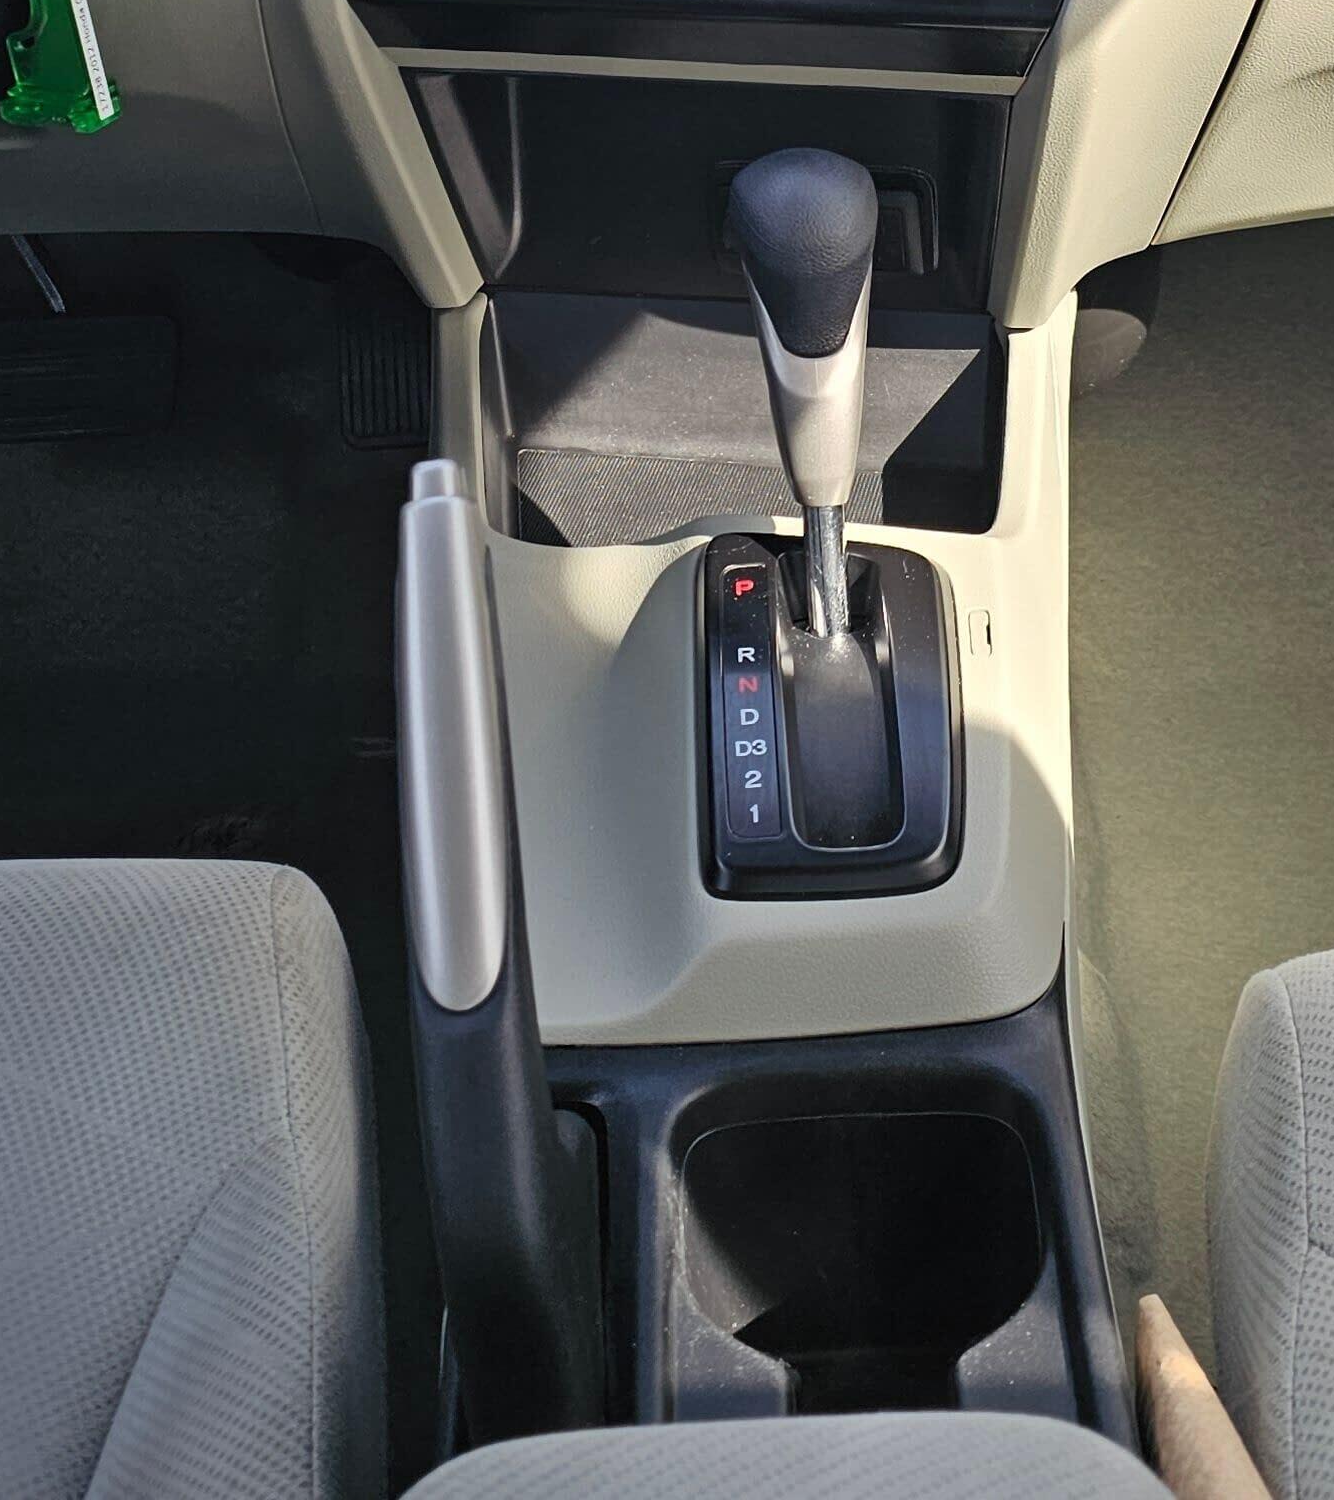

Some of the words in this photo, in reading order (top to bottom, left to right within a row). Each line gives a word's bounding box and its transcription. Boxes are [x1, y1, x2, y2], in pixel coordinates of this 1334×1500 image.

[79, 7, 93, 44] Honda
[735, 579, 755, 596] P
[737, 646, 756, 663] R
[738, 676, 759, 693] N
[739, 708, 760, 726] D
[734, 738, 768, 757] D3
[744, 770, 763, 789] 2
[749, 803, 760, 824] 1
